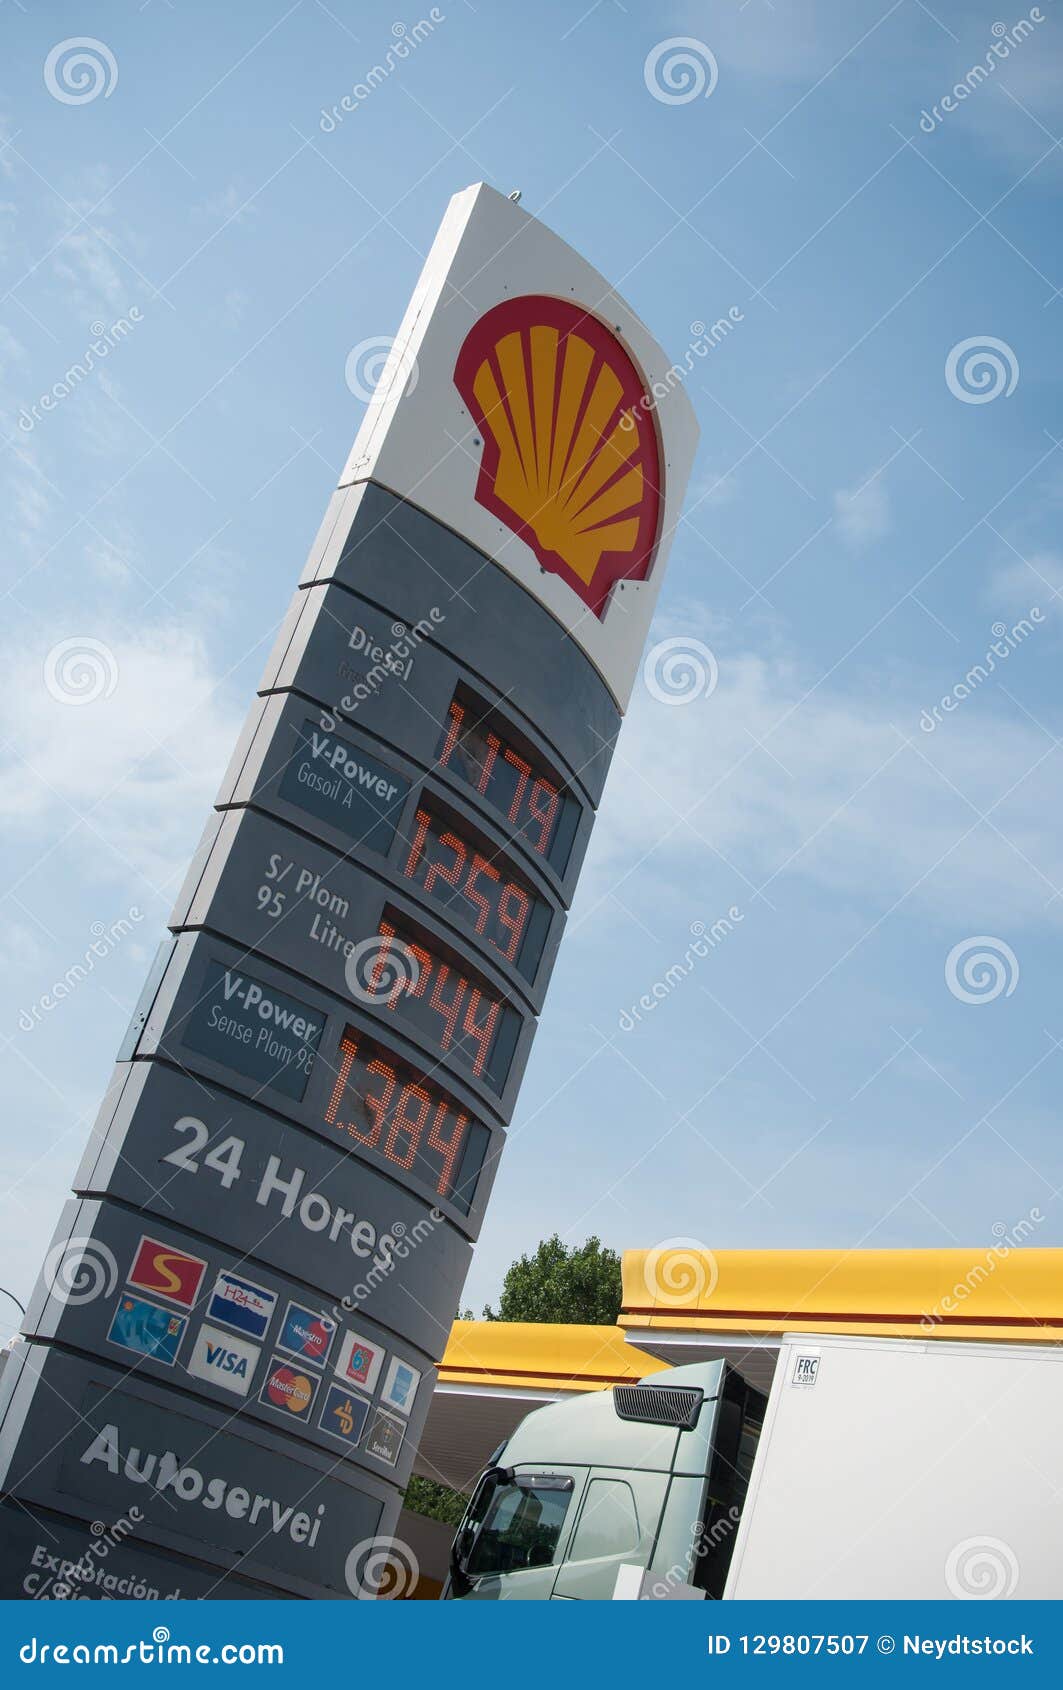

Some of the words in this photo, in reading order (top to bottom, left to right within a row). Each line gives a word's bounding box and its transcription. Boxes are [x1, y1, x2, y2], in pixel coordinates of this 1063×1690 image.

[348, 626, 414, 681] Diesel
[298, 762, 342, 800] Gasoil
[342, 788, 354, 808] A
[312, 732, 398, 801] V-Power
[265, 854, 294, 882] S/
[295, 869, 349, 918] Plom
[257, 886, 286, 917] 95
[310, 913, 356, 959] Litre
[208, 1005, 253, 1043] Sense
[256, 1027, 293, 1064] Plom
[224, 972, 317, 1041] V-Power
[162, 1116, 246, 1189] 24
[256, 1154, 400, 1270] Hores
[205, 1341, 249, 1378] VISA
[797, 1359, 818, 1374] FRC
[80, 1423, 326, 1548] Autoservei
